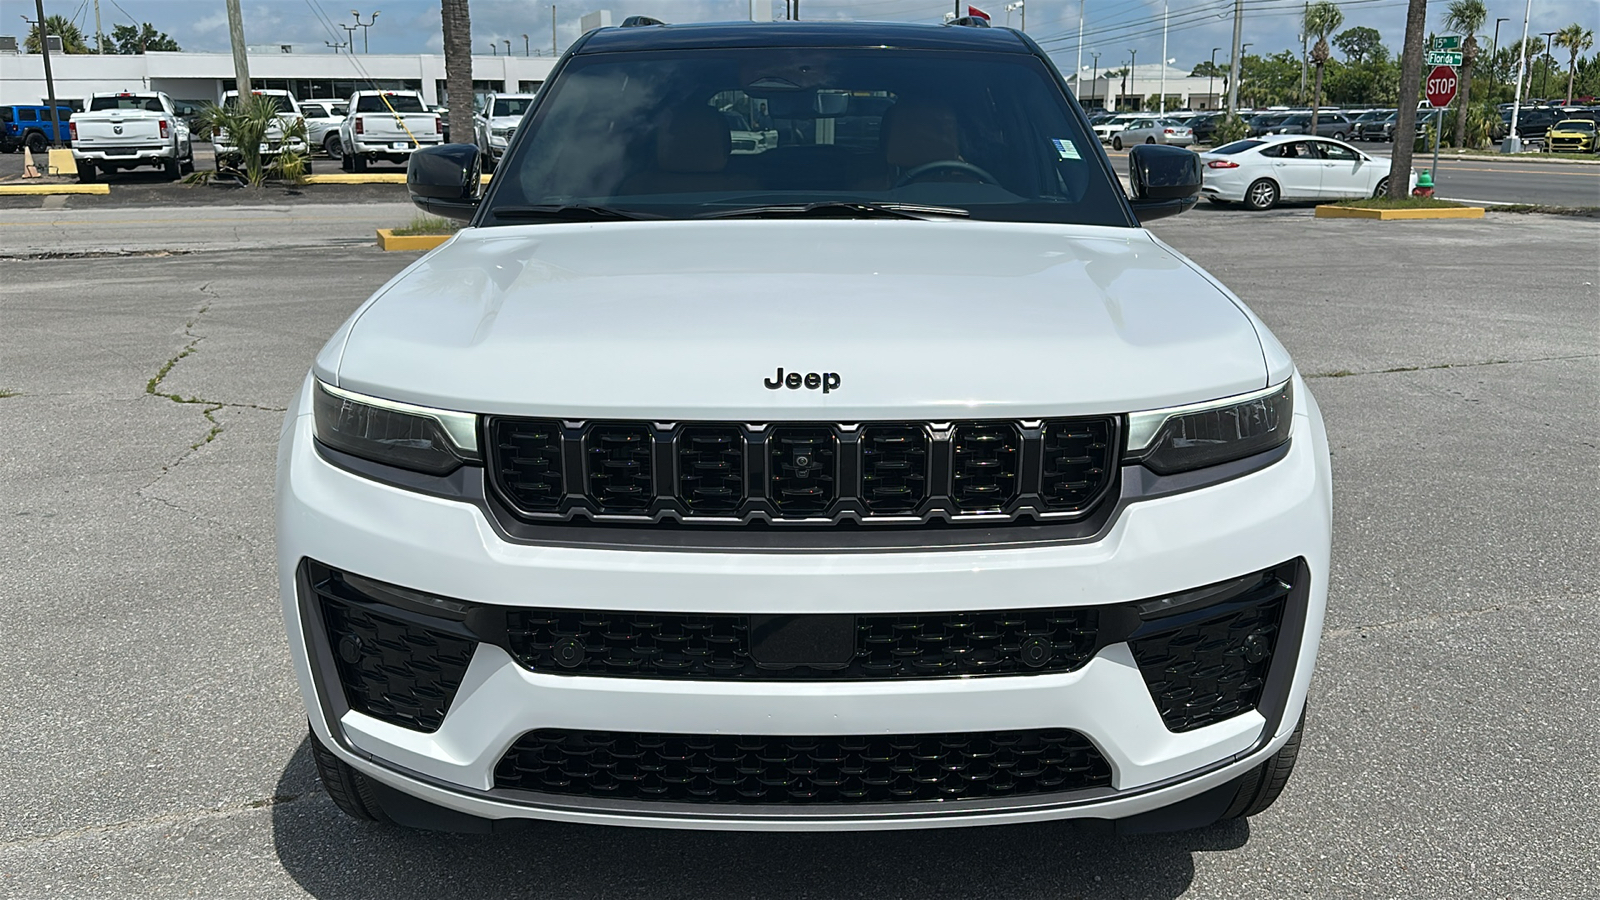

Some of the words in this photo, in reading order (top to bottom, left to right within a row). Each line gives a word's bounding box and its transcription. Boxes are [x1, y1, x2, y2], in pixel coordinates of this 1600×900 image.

[1430, 53, 1453, 64] Florida
[1428, 78, 1455, 95] STOP
[764, 367, 841, 394] Jeep
